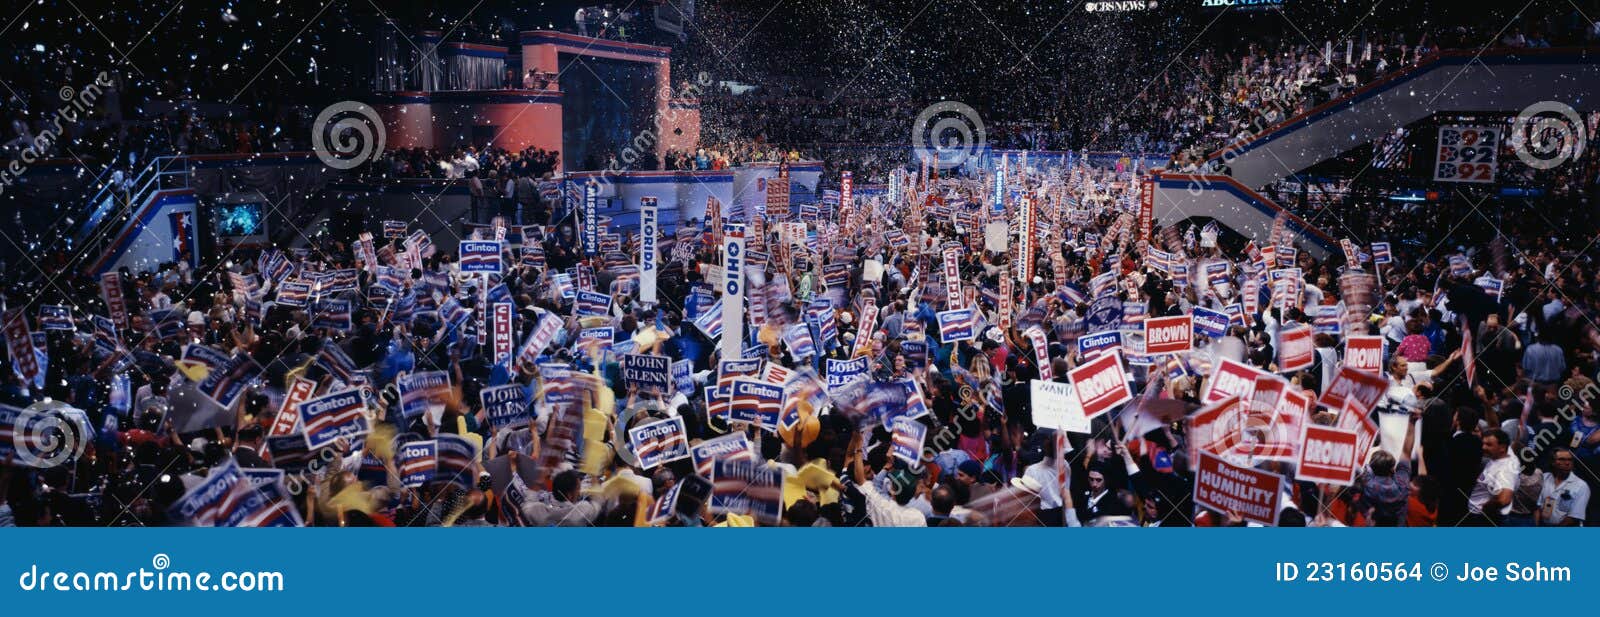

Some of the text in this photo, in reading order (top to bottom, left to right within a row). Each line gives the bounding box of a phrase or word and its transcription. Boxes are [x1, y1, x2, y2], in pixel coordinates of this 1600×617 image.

[586, 187, 596, 253] MISSISSIPPI
[465, 243, 497, 252] Clinton
[643, 209, 654, 272] FLORIDA
[726, 241, 740, 296] OHIO
[581, 293, 607, 304] Clinton
[1194, 315, 1225, 331] Clinton
[580, 330, 609, 339] Clinton
[1082, 335, 1117, 349] Clinton
[1149, 324, 1189, 344] BROWN
[628, 355, 665, 369] JOHN
[725, 361, 758, 373] Clinton
[829, 358, 866, 373] JOHN
[1347, 348, 1381, 369] BROWN
[625, 368, 668, 383] GLENN
[1077, 364, 1123, 399] BROWN
[740, 383, 780, 399] Clinton
[306, 394, 357, 416] Clinton
[636, 422, 677, 442] Clinton
[1304, 438, 1353, 467] BROWN
[1217, 463, 1258, 485] Restore
[1200, 470, 1275, 506] HUMILITY
[1209, 490, 1272, 517] GOVERNMENT
